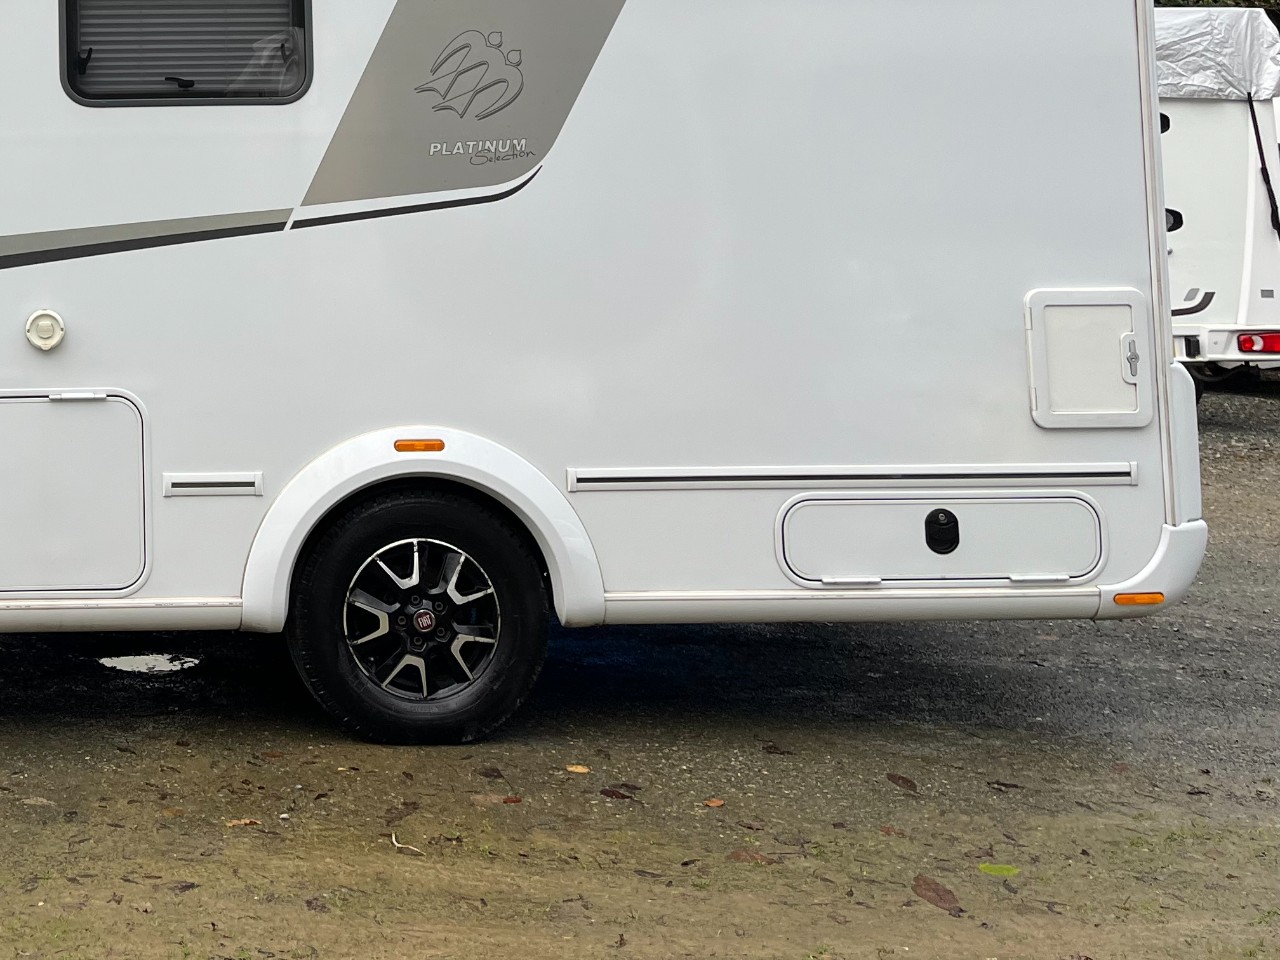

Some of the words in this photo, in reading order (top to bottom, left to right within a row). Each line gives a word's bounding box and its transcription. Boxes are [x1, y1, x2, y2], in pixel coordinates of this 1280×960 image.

[429, 138, 527, 156] PLATINUM
[470, 148, 536, 165] Selection
[418, 615, 431, 628] FIAT
